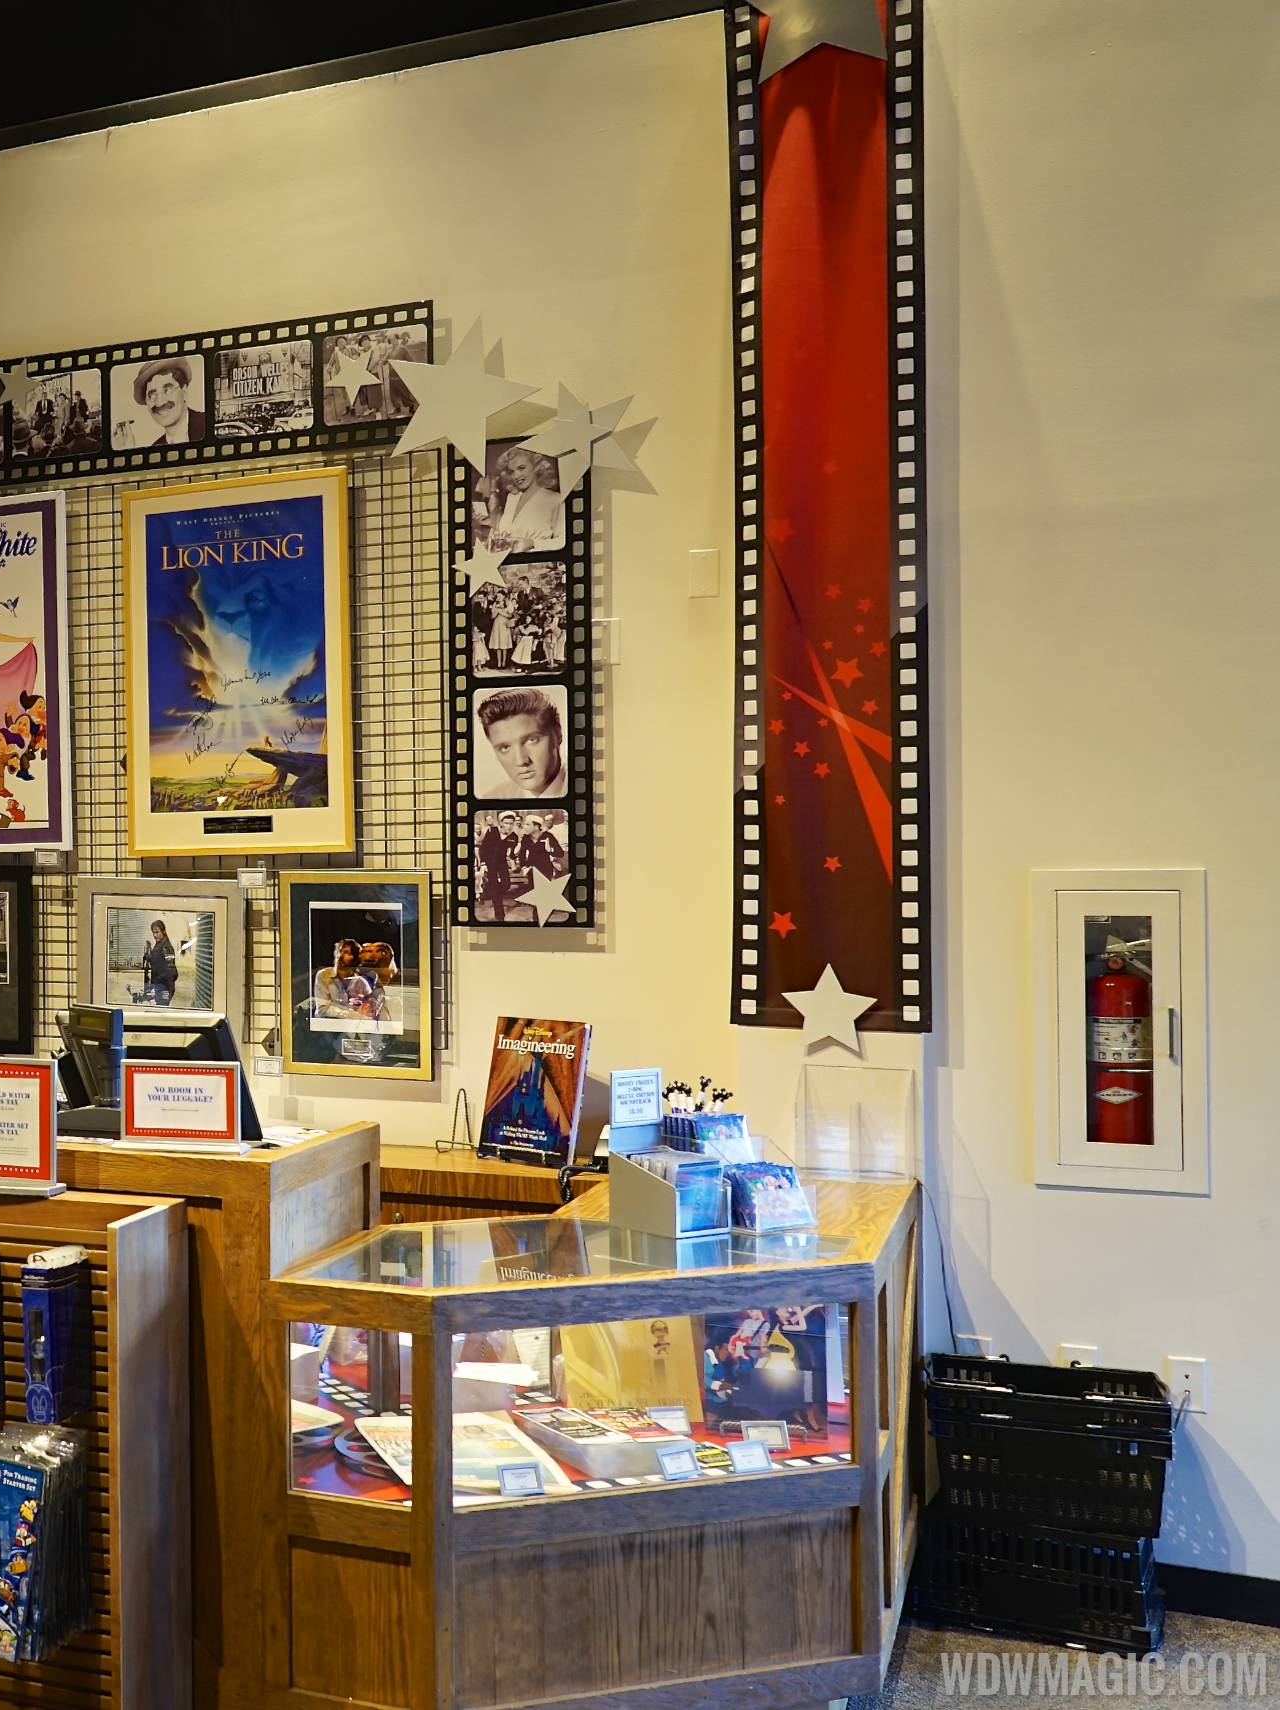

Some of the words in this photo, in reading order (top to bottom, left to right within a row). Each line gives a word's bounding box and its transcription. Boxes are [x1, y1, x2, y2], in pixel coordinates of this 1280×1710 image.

[232, 365, 258, 381] ORSON
[232, 378, 263, 397] CITIZEN
[266, 375, 289, 394] KA
[215, 529, 241, 540] THE
[160, 544, 225, 570] LION
[232, 533, 305, 564] KING
[497, 1034, 577, 1059] Imagineering
[168, 1086, 192, 1094] ROOM
[148, 1094, 170, 1102] YOUR
[172, 1095, 213, 1103] LUGGAGE?
[17, 1122, 29, 1130] SET
